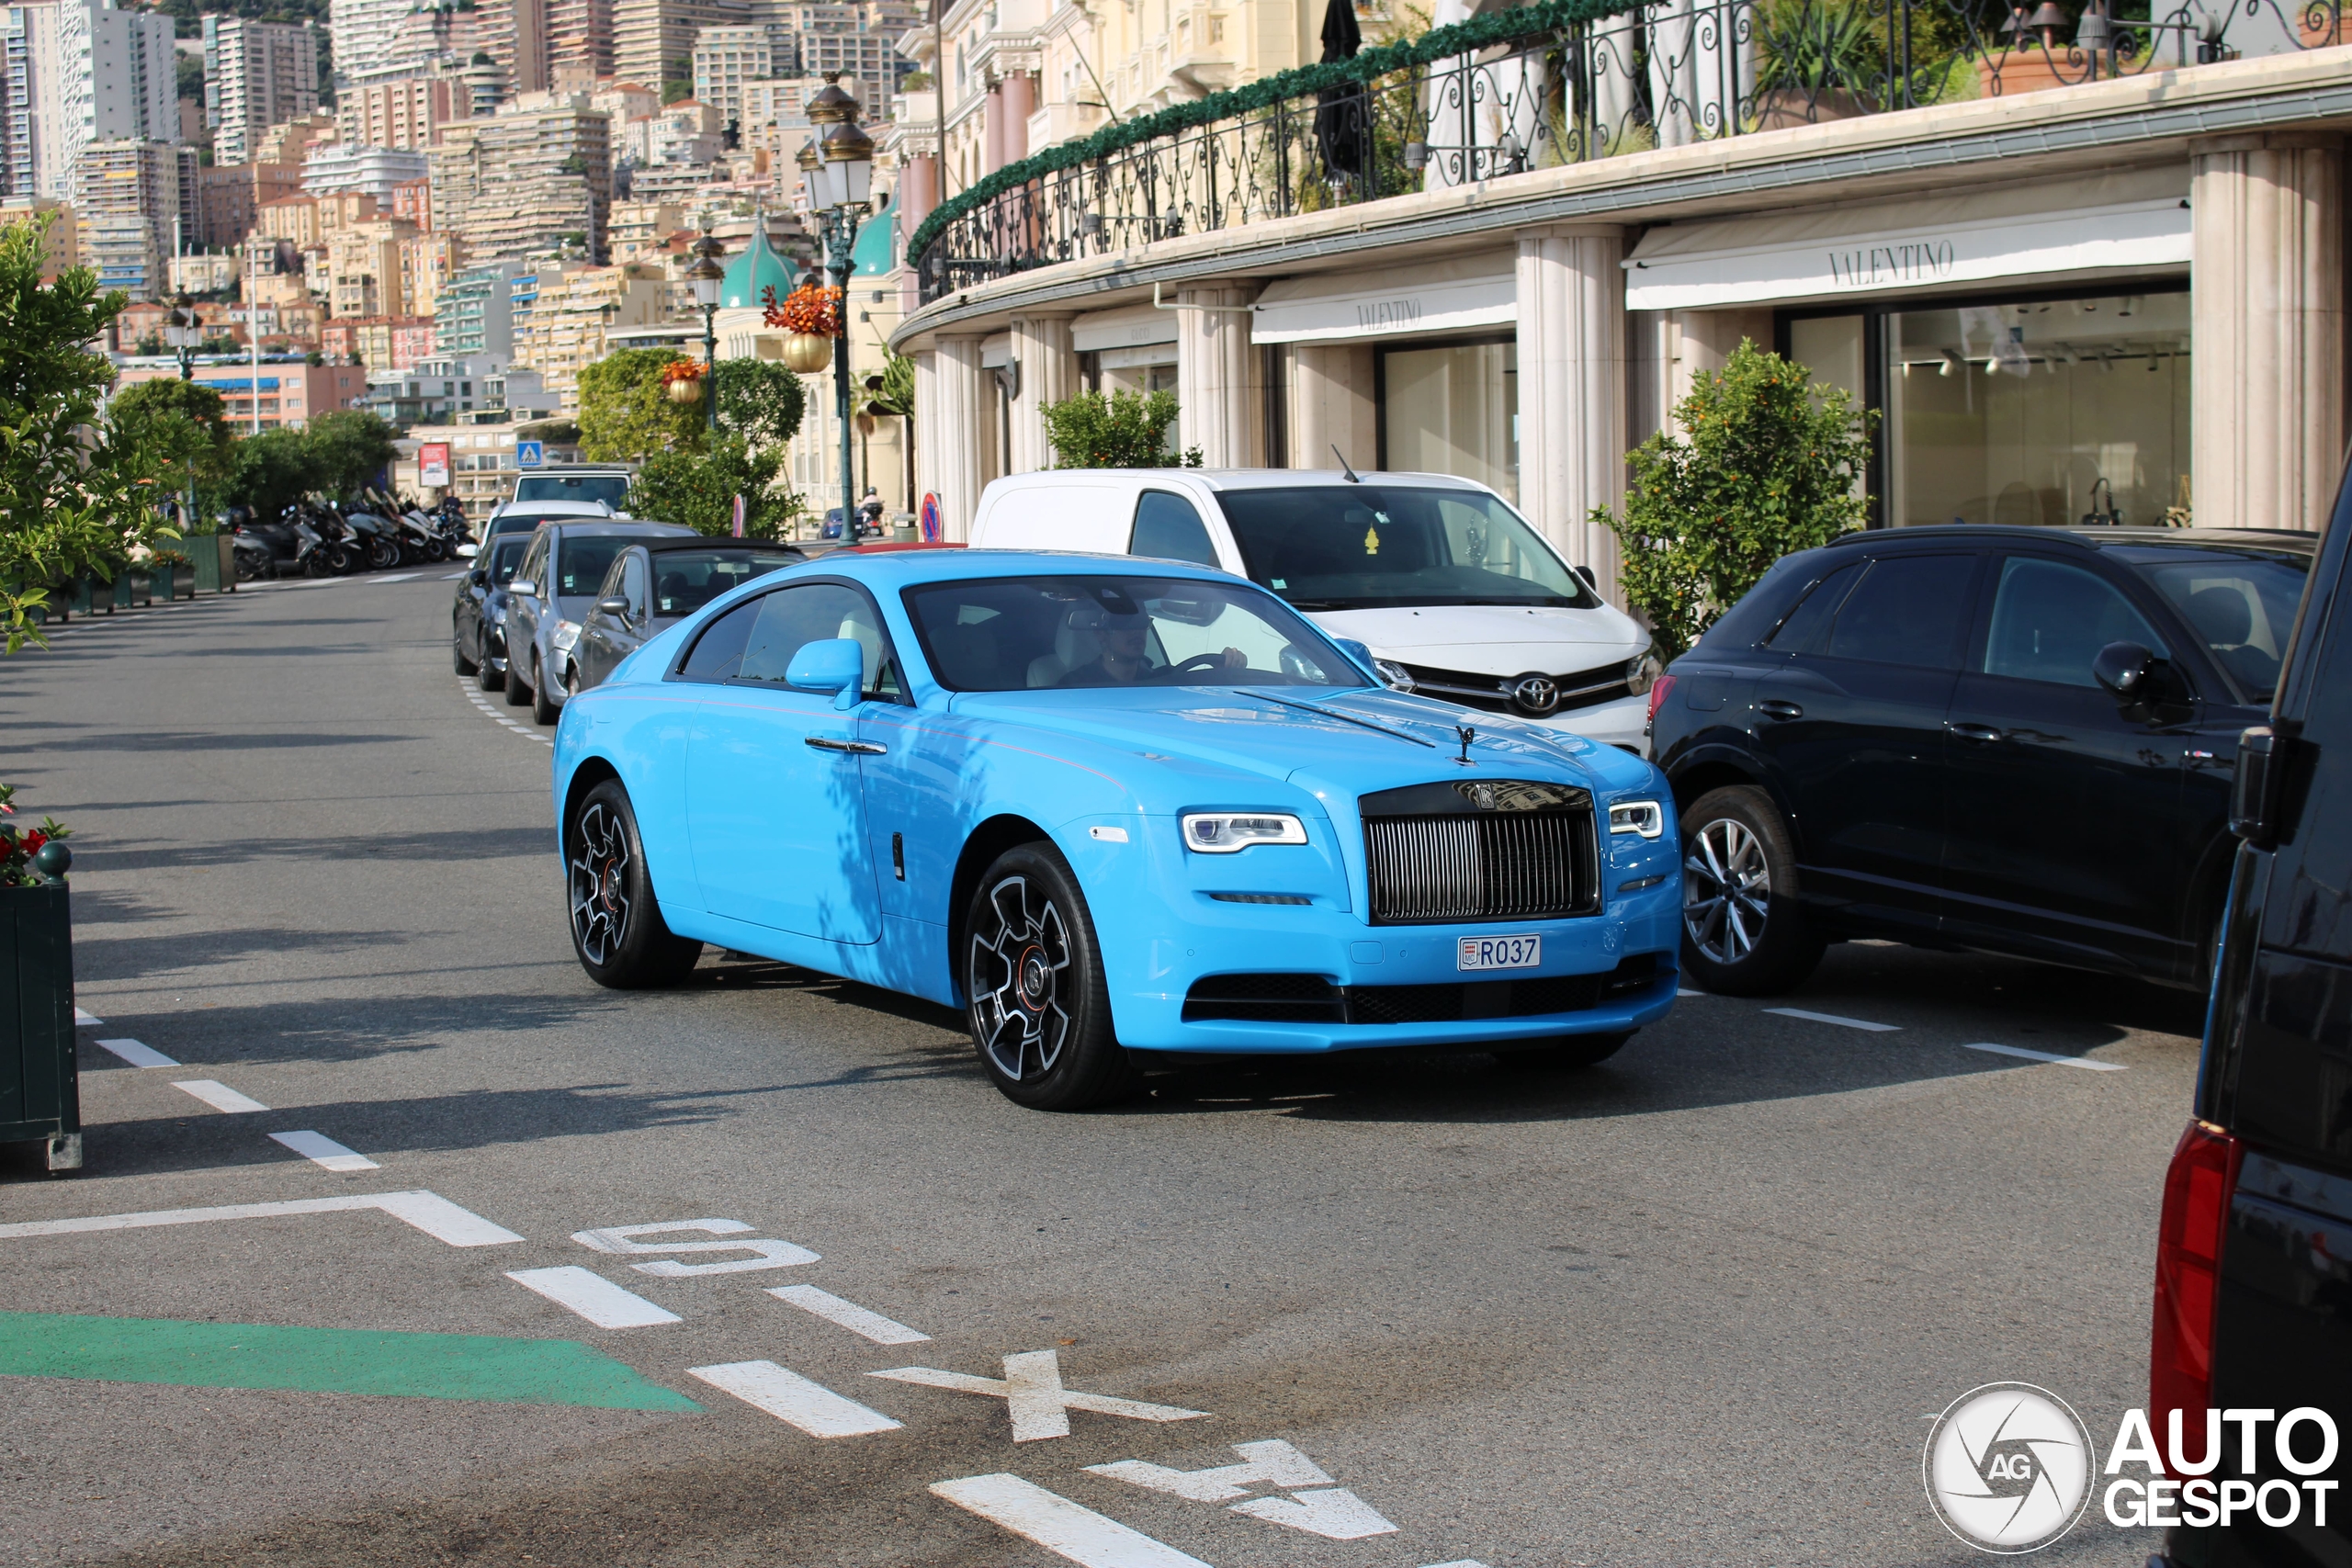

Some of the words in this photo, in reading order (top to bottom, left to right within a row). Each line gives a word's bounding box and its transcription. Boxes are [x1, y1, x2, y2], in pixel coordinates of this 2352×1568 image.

[1828, 239, 1954, 287] VALENTINO
[1357, 298, 1421, 331] VALENTINO
[1480, 939, 1536, 964] R037
[570, 1218, 1490, 1568] AXIS
